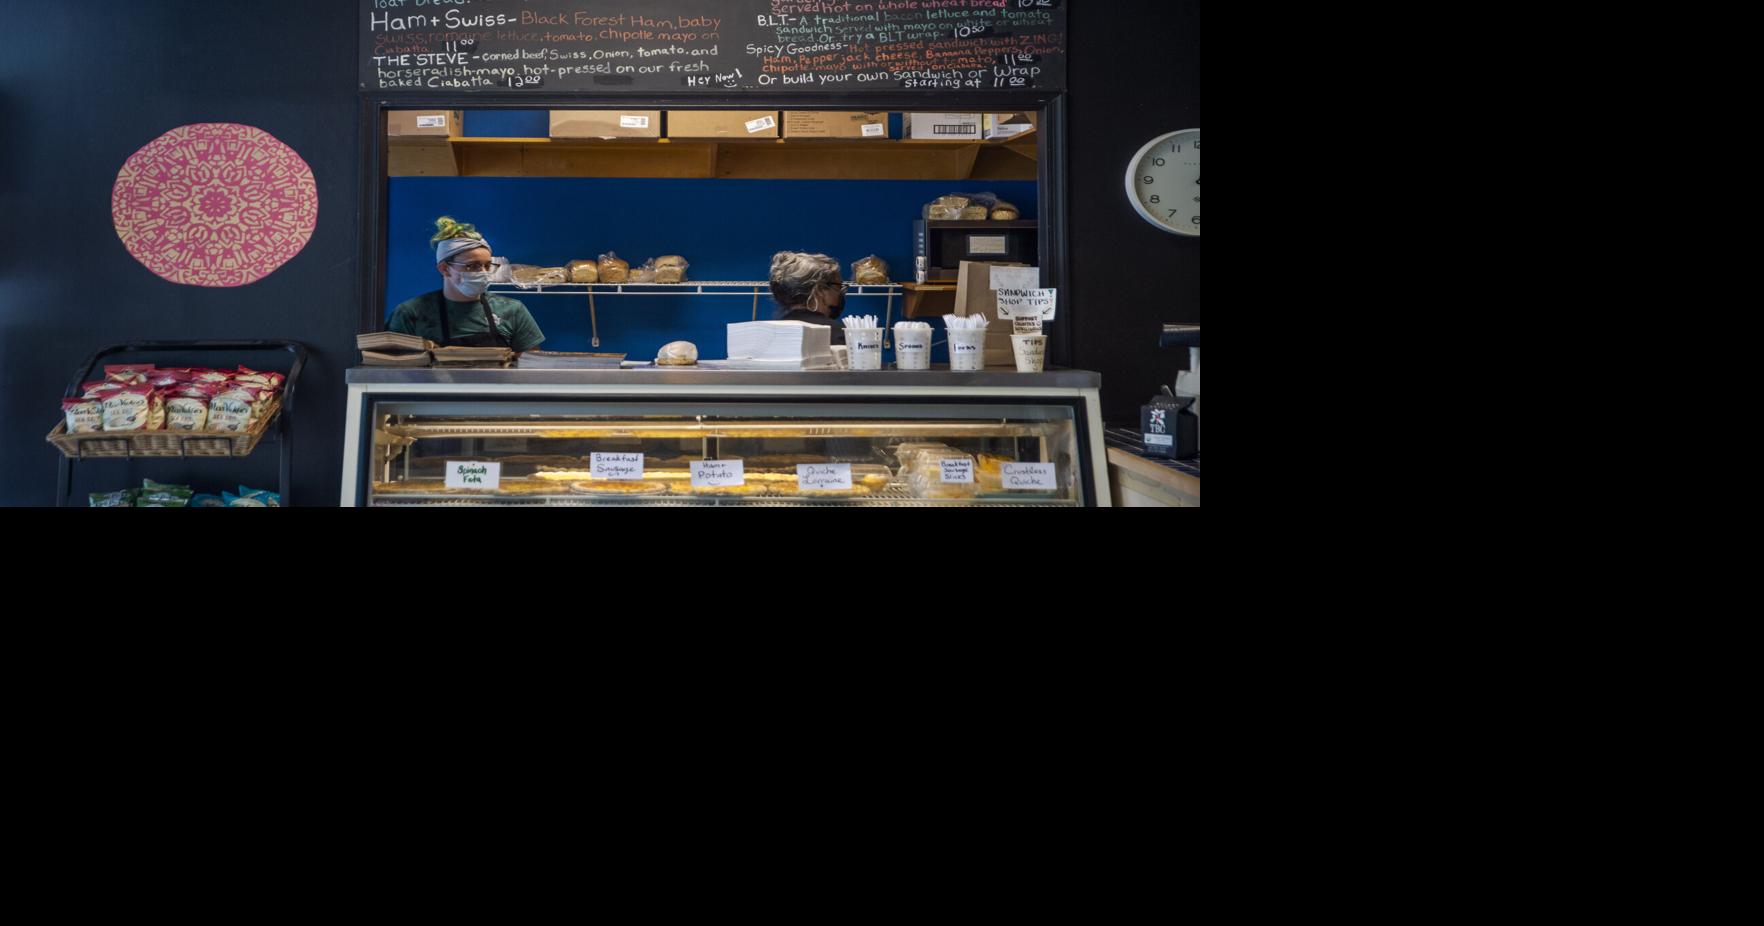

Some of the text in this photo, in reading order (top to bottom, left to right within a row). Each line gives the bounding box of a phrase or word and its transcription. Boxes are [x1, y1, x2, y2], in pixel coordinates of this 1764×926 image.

[772, 1, 823, 16] served
[855, 4, 873, 12] on
[880, 0, 918, 10] whole
[922, 0, 965, 9] wheat
[970, 0, 1007, 9] bread
[371, 11, 427, 31] Ham
[522, 11, 569, 27] Black
[574, 11, 625, 27] Forest
[679, 16, 721, 33] baby
[799, 15, 808, 26] A
[814, 11, 880, 25] traditional
[926, 8, 970, 20] lettuce
[973, 8, 997, 17] and
[999, 8, 1051, 20] tomato
[776, 24, 834, 35] sandwich
[874, 22, 901, 32] with
[903, 22, 937, 32] mayo
[940, 22, 954, 31] on
[956, 18, 993, 29] white
[658, 31, 697, 44] mayo
[702, 31, 721, 41] on
[843, 33, 861, 45] try
[879, 31, 906, 43] BLT
[746, 43, 784, 59] Spicy
[875, 40, 924, 55] pressed
[930, 38, 988, 50] sandwich
[990, 37, 1018, 48] with
[373, 55, 411, 66] THE
[482, 49, 520, 61] corned
[691, 45, 719, 57] and
[800, 51, 839, 66] Pepper
[842, 51, 872, 66] jack
[925, 47, 972, 60] Banana
[616, 64, 636, 74] on
[639, 64, 666, 74] our
[669, 60, 711, 73] fresh
[852, 61, 878, 72] with
[380, 77, 422, 89] baked
[427, 76, 494, 88] Ciabatta
[758, 73, 778, 85] Or
[782, 72, 815, 85] build
[819, 72, 853, 86] your
[857, 70, 890, 83] own
[894, 67, 963, 82] sandwich
[967, 68, 988, 79] or
[904, 77, 961, 89] starting
[964, 77, 982, 89] at
[1171, 143, 1181, 153] 11
[1152, 157, 1166, 167] 10
[1143, 175, 1154, 185] 9
[1149, 194, 1161, 204] 8
[1167, 208, 1178, 218] 7
[998, 288, 1045, 299] SANDWICH
[999, 298, 1023, 306] SHOP
[698, 470, 733, 479] Potato
